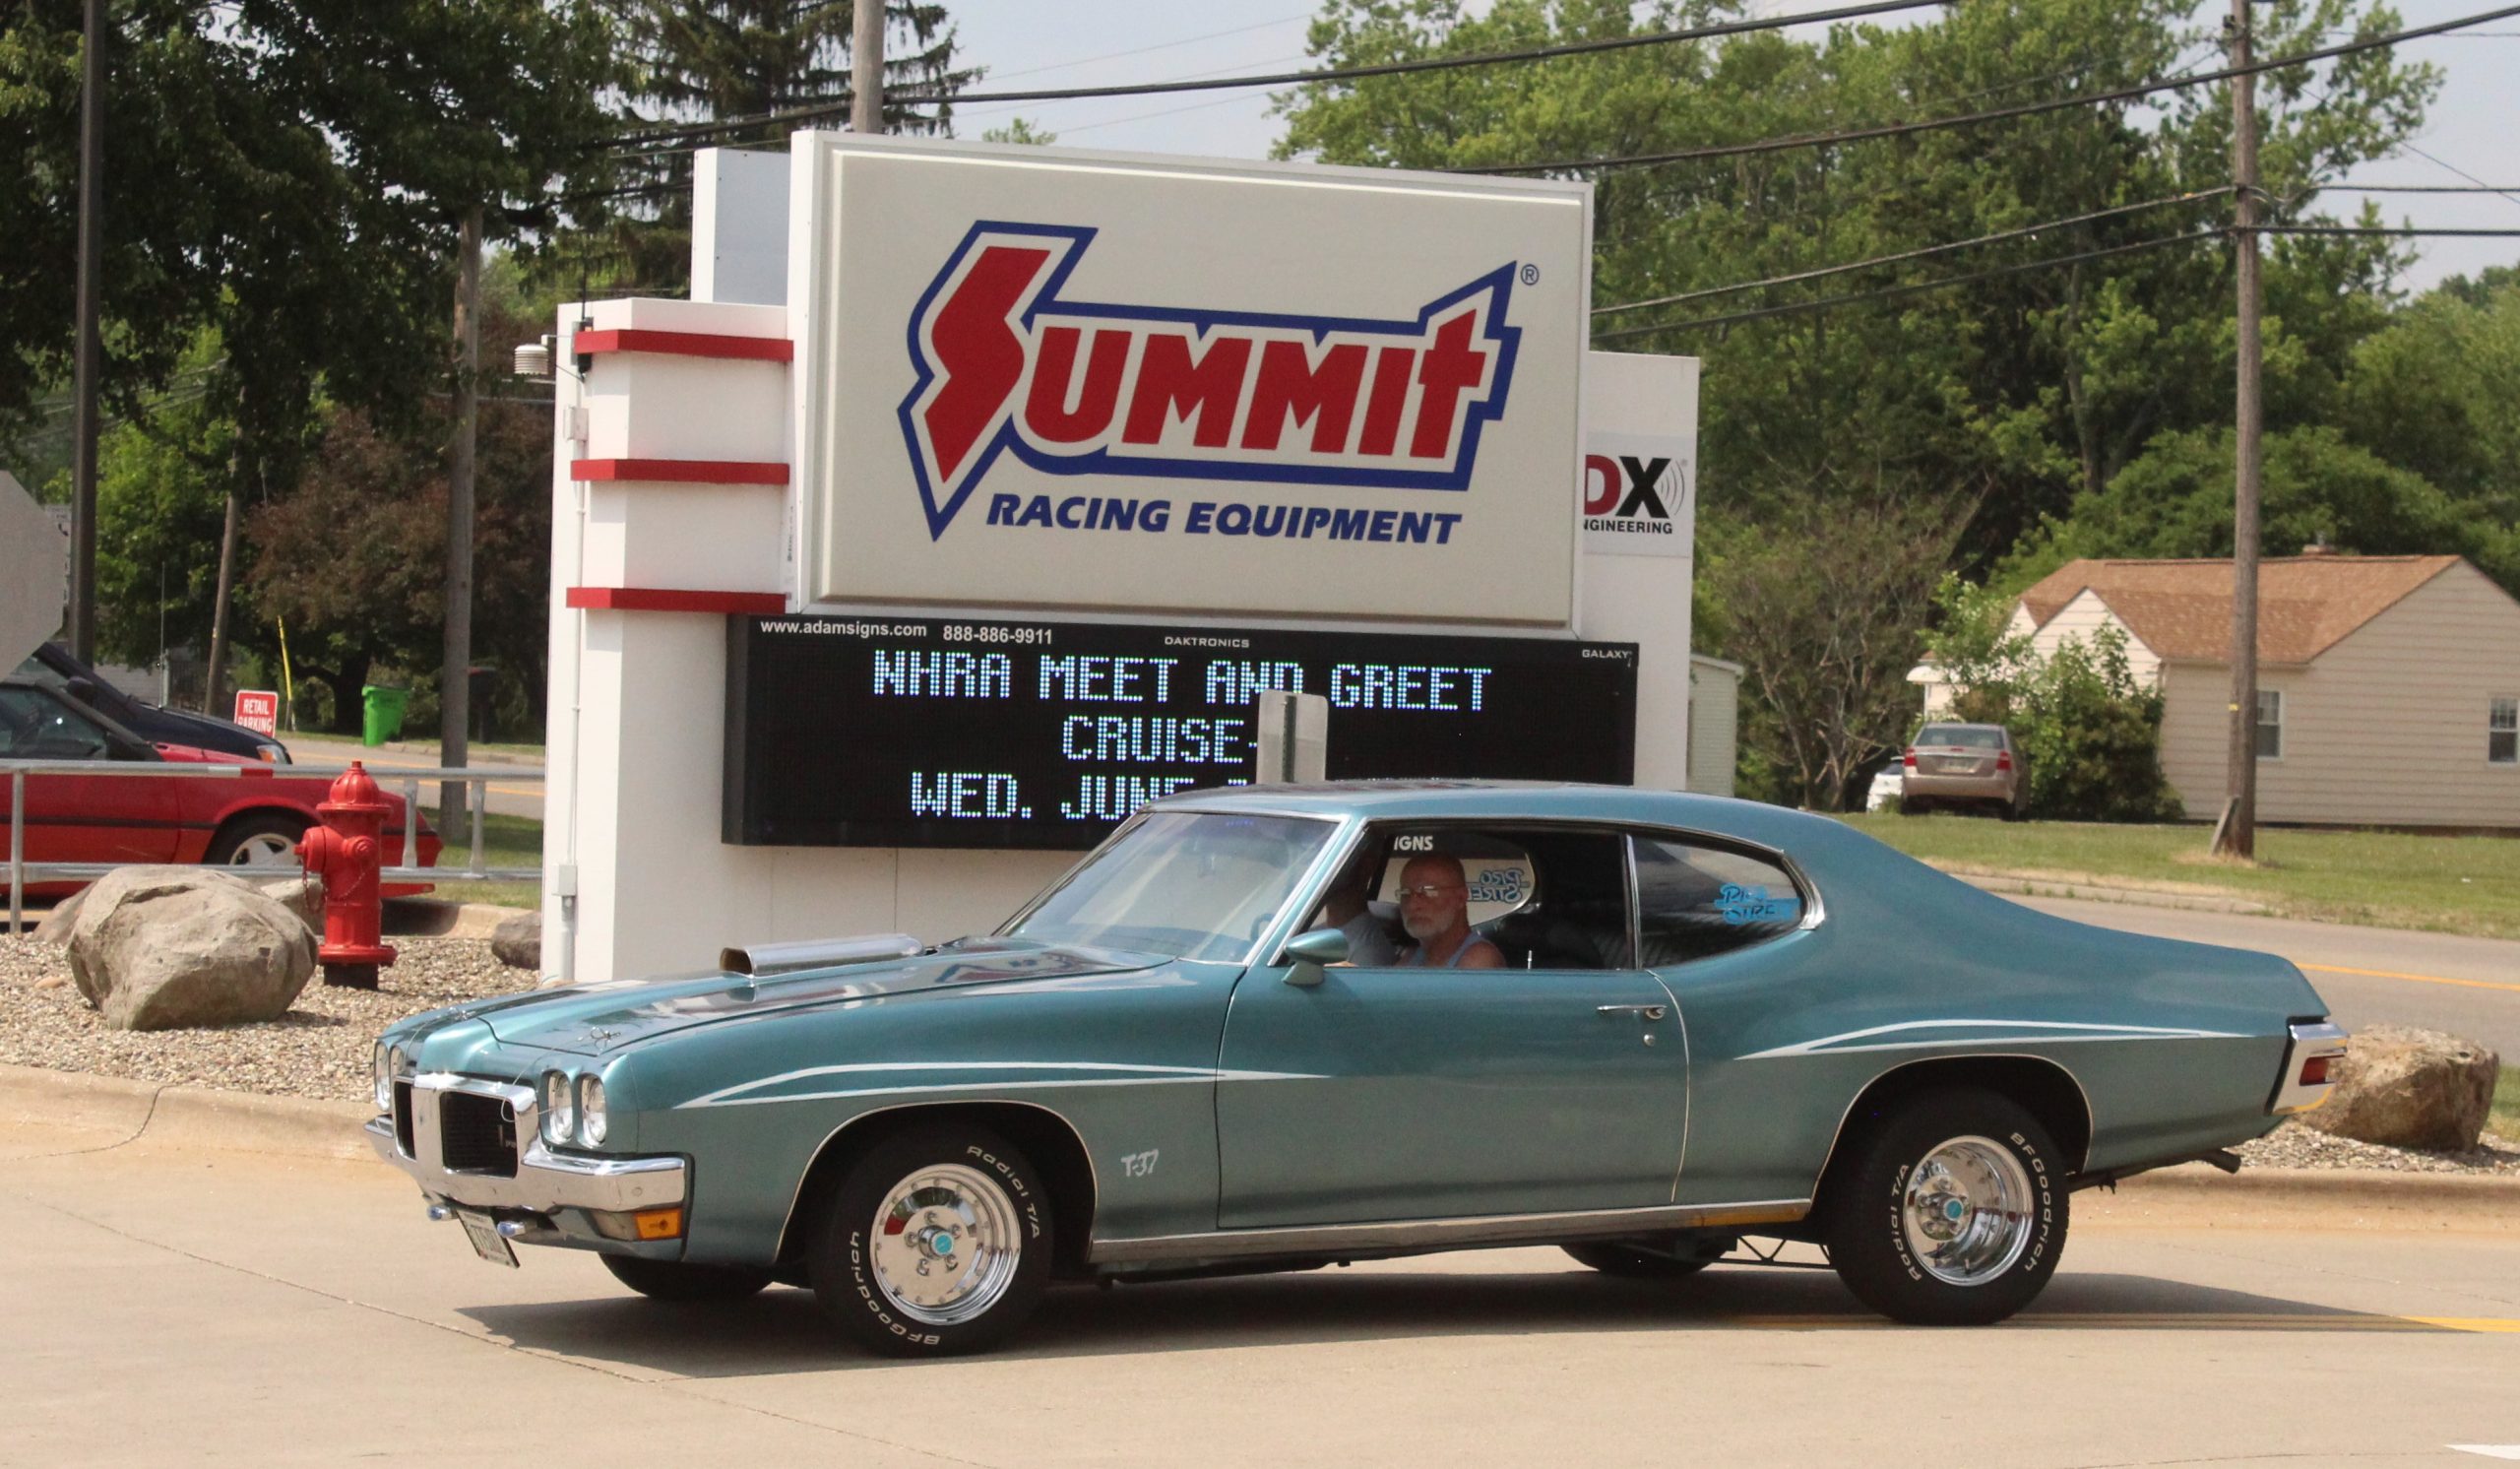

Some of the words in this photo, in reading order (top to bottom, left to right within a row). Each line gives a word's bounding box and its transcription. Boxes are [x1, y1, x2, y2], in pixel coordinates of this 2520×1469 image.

[1583, 454, 1671, 519] DX
[987, 493, 1169, 533] RACING
[1185, 501, 1462, 544] EQUIPMENT
[761, 618, 927, 638] www.adamsigns.com
[942, 624, 1053, 645] 888-886-9911
[1164, 635, 1250, 649] DAKTRONICS
[1582, 649, 1628, 659] GALAXY
[873, 650, 1011, 699] NHRA
[1039, 654, 1178, 703] MEET
[1206, 659, 1304, 706] AND
[1330, 664, 1492, 712] GREET
[243, 698, 270, 716] RETAIL
[911, 771, 1032, 819] WED.
[1120, 1148, 1160, 1178] T-37
[967, 1145, 1029, 1203] Radial
[1026, 1202, 1040, 1239] T/A
[2010, 1132, 2052, 1272] BFGoodrich
[1890, 1206, 1922, 1281] Radial
[850, 1231, 941, 1346] BFGoodrich
